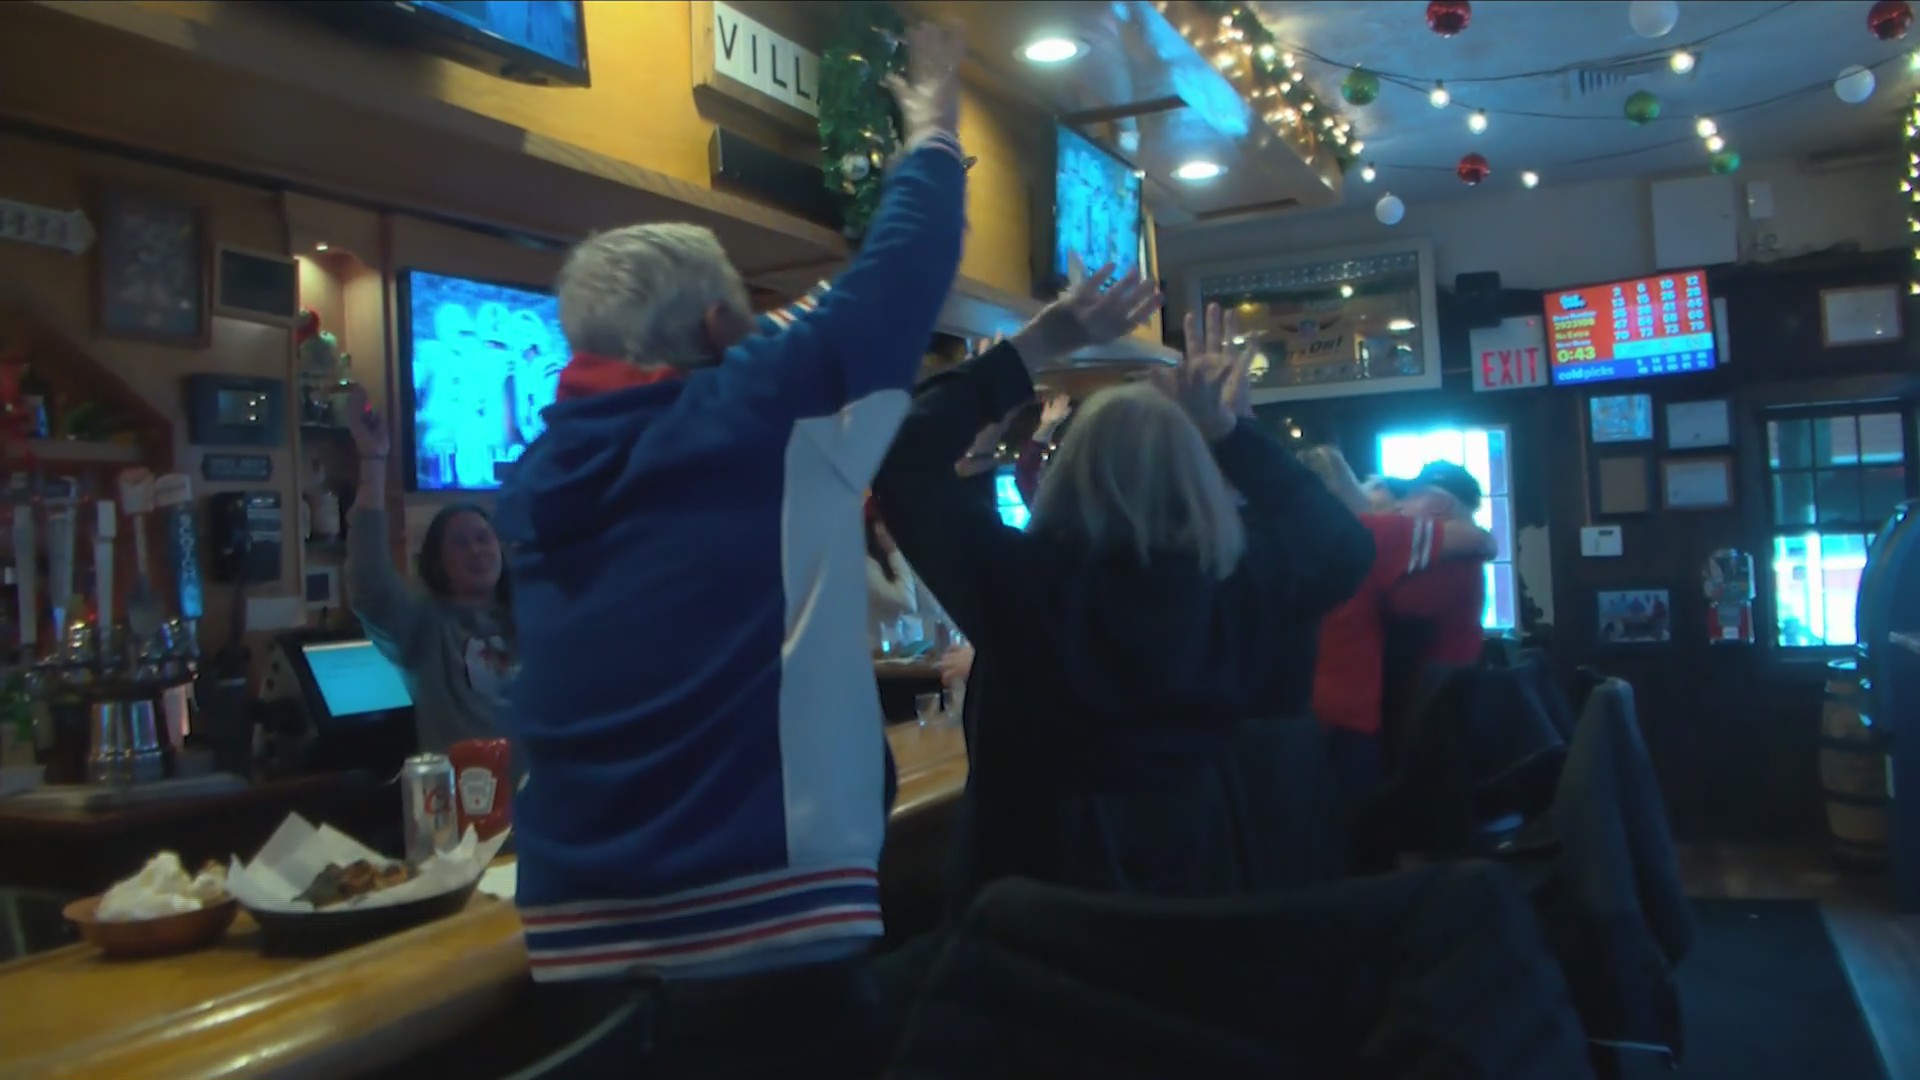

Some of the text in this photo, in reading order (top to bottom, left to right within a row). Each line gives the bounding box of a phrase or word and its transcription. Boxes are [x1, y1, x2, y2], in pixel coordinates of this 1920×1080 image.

[717, 14, 820, 106] VILL
[1481, 347, 1539, 388] EXIT
[1557, 345, 1596, 363] 0:43
